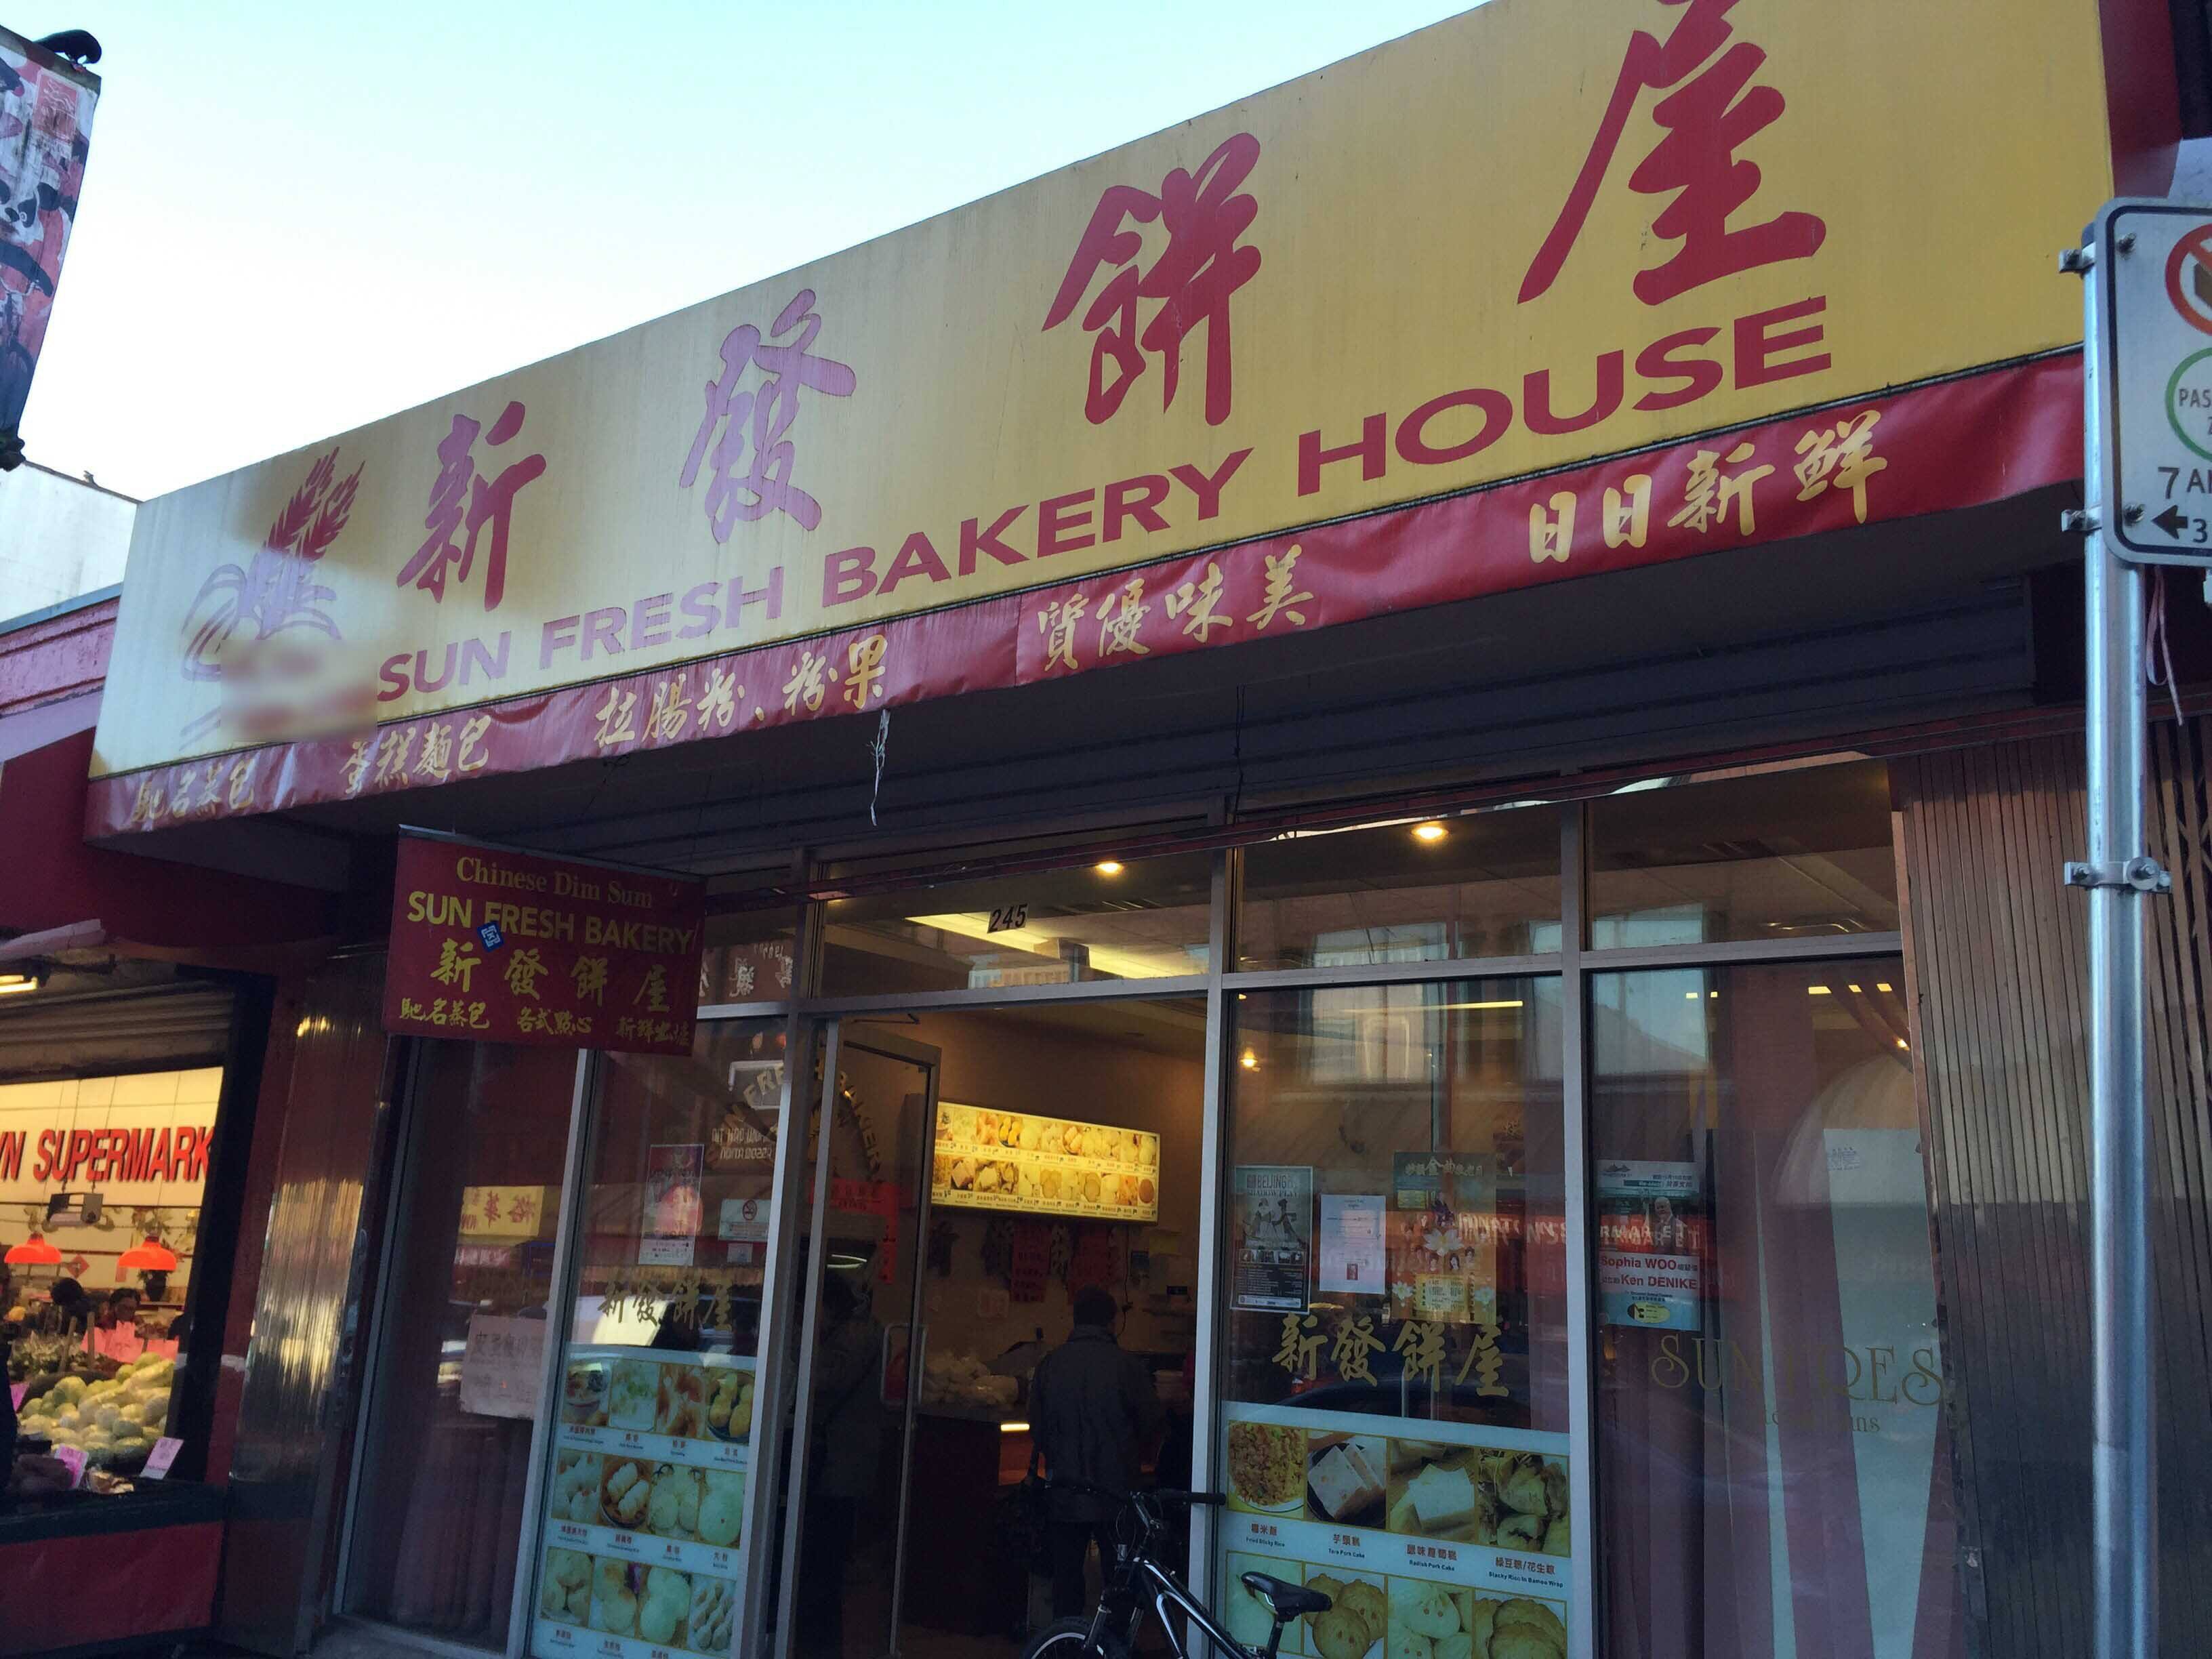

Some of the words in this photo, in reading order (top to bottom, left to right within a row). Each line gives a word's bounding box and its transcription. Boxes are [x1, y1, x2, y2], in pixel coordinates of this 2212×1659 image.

[398, 0, 1826, 612] 新發餅屋
[377, 631, 510, 701] SUN
[541, 567, 782, 670] FRESH
[821, 447, 1254, 609] BAKERY
[1298, 295, 1832, 498] HOUSE
[2158, 466, 2179, 499] 7
[1038, 544, 1313, 671] 質優味美
[1529, 410, 1887, 563] 日日新鮮
[2193, 518, 2207, 544] 3
[455, 856, 546, 893] Chinese
[553, 869, 600, 901] Dim
[607, 880, 651, 909] Sum
[407, 890, 472, 928] SUN
[485, 900, 575, 942] FRESH
[585, 916, 695, 955] BAKERY
[988, 903, 1027, 932] 245
[430, 938, 670, 1013] 新發餅屋
[1257, 1174, 1286, 1188] BEIJING
[1601, 1256, 1641, 1269] Sophia
[1645, 1258, 1677, 1270] WOO
[1621, 1275, 1643, 1286] Ken
[1647, 1276, 1698, 1289] DENIKE
[1272, 1313, 1509, 1397] 新發餅屋
